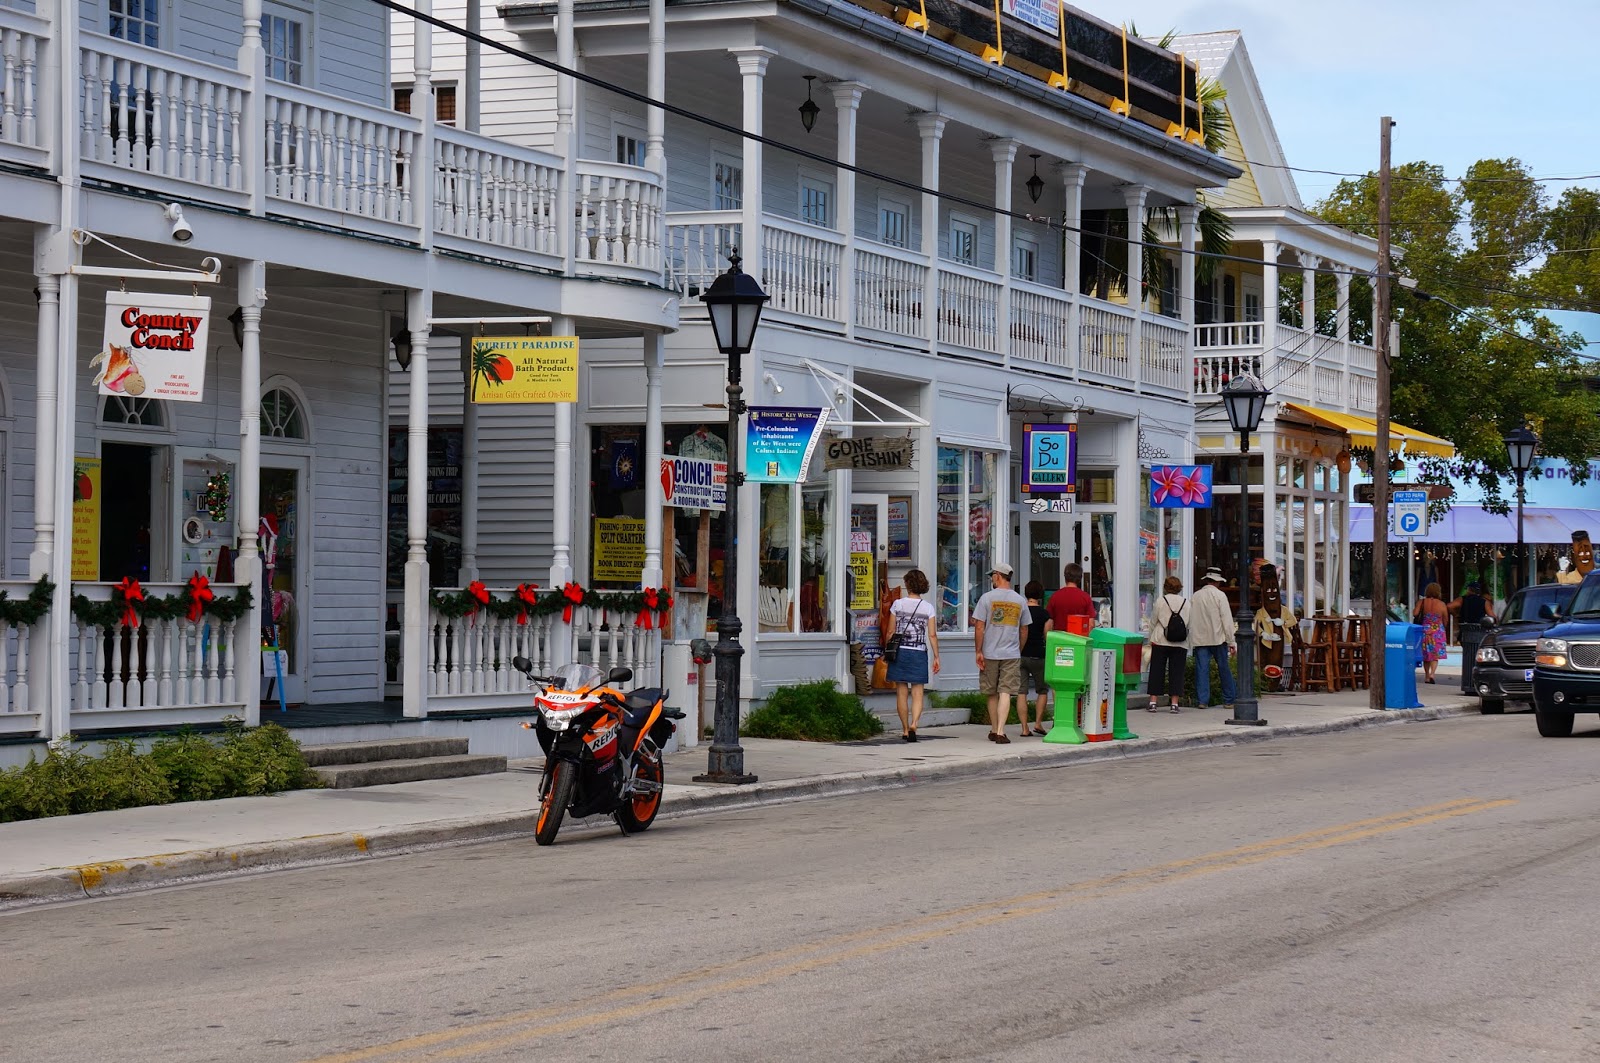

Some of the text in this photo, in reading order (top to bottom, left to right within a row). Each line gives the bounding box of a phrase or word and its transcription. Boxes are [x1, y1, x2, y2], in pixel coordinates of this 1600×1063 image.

[121, 307, 203, 334] Country
[130, 328, 194, 352] Conch
[477, 341, 575, 350] PURELY PARADISE
[506, 390, 520, 399] Gifts
[522, 390, 546, 399] Crafted
[813, 408, 828, 438] PARADISE
[828, 437, 874, 459] GONE
[1038, 437, 1059, 452] So
[852, 449, 906, 468] FISHIN'
[1038, 452, 1059, 467] Du
[675, 459, 712, 486] CONCH
[1032, 472, 1066, 483] GALLERY
[674, 484, 711, 496] CONSTRUCTION
[678, 496, 700, 506] ROOFING
[1052, 500, 1069, 512] ART
[600, 523, 620, 531] FISHING
[1406, 517, 1416, 528] P
[601, 532, 616, 543] SPLIT
